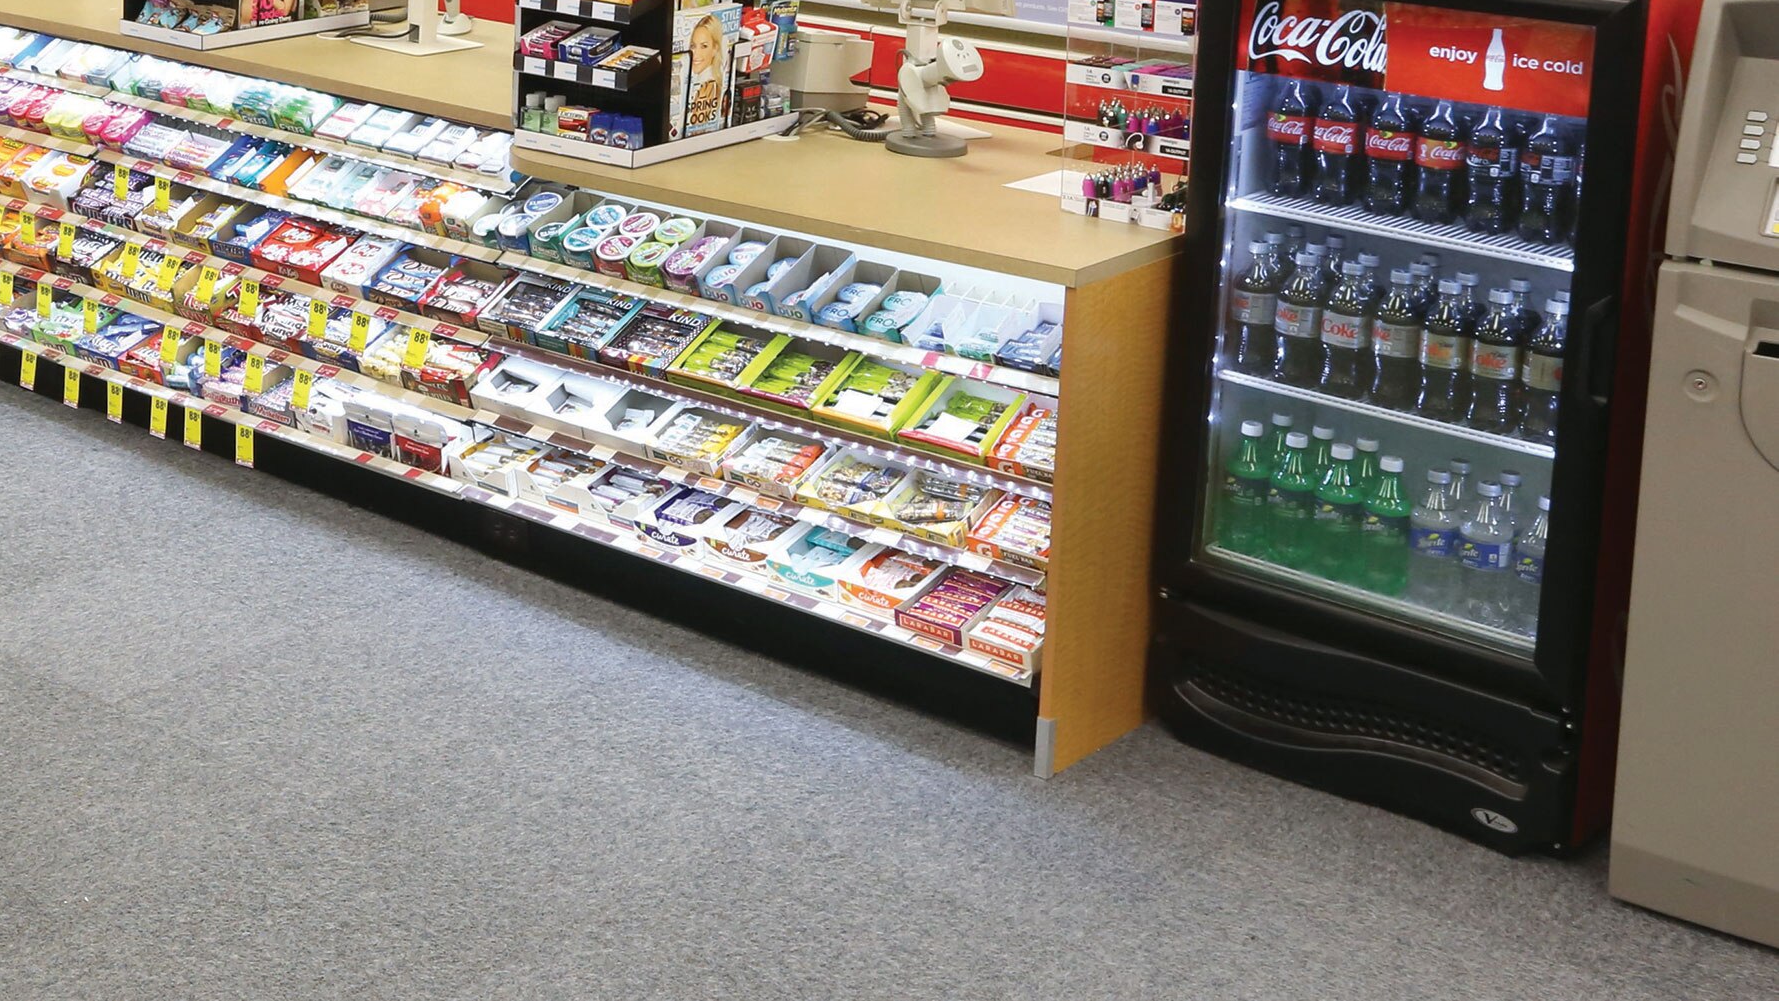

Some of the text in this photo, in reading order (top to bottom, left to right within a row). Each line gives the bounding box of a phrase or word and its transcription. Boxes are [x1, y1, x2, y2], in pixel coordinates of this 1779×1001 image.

[721, 9, 741, 23] STYLE
[723, 22, 740, 33] ATCH
[1249, 1, 1387, 74] Coca-Cola
[1429, 44, 1478, 65] enjoy
[1512, 53, 1540, 70] ice
[1543, 57, 1584, 76] cold
[545, 282, 572, 294] KIND
[705, 288, 729, 301] DUO
[606, 298, 633, 311] KIND
[738, 297, 764, 311] DUO
[778, 306, 804, 320] DUO
[824, 305, 850, 318] FRO
[669, 313, 702, 326] KIND
[869, 316, 899, 328] FRO
[1322, 317, 1358, 340] Coke
[651, 530, 680, 547] curate
[721, 546, 750, 562] curate
[784, 570, 814, 586] curate
[858, 590, 889, 607] curate
[903, 617, 949, 639] LARABAR
[971, 640, 1020, 661] LARABAR
